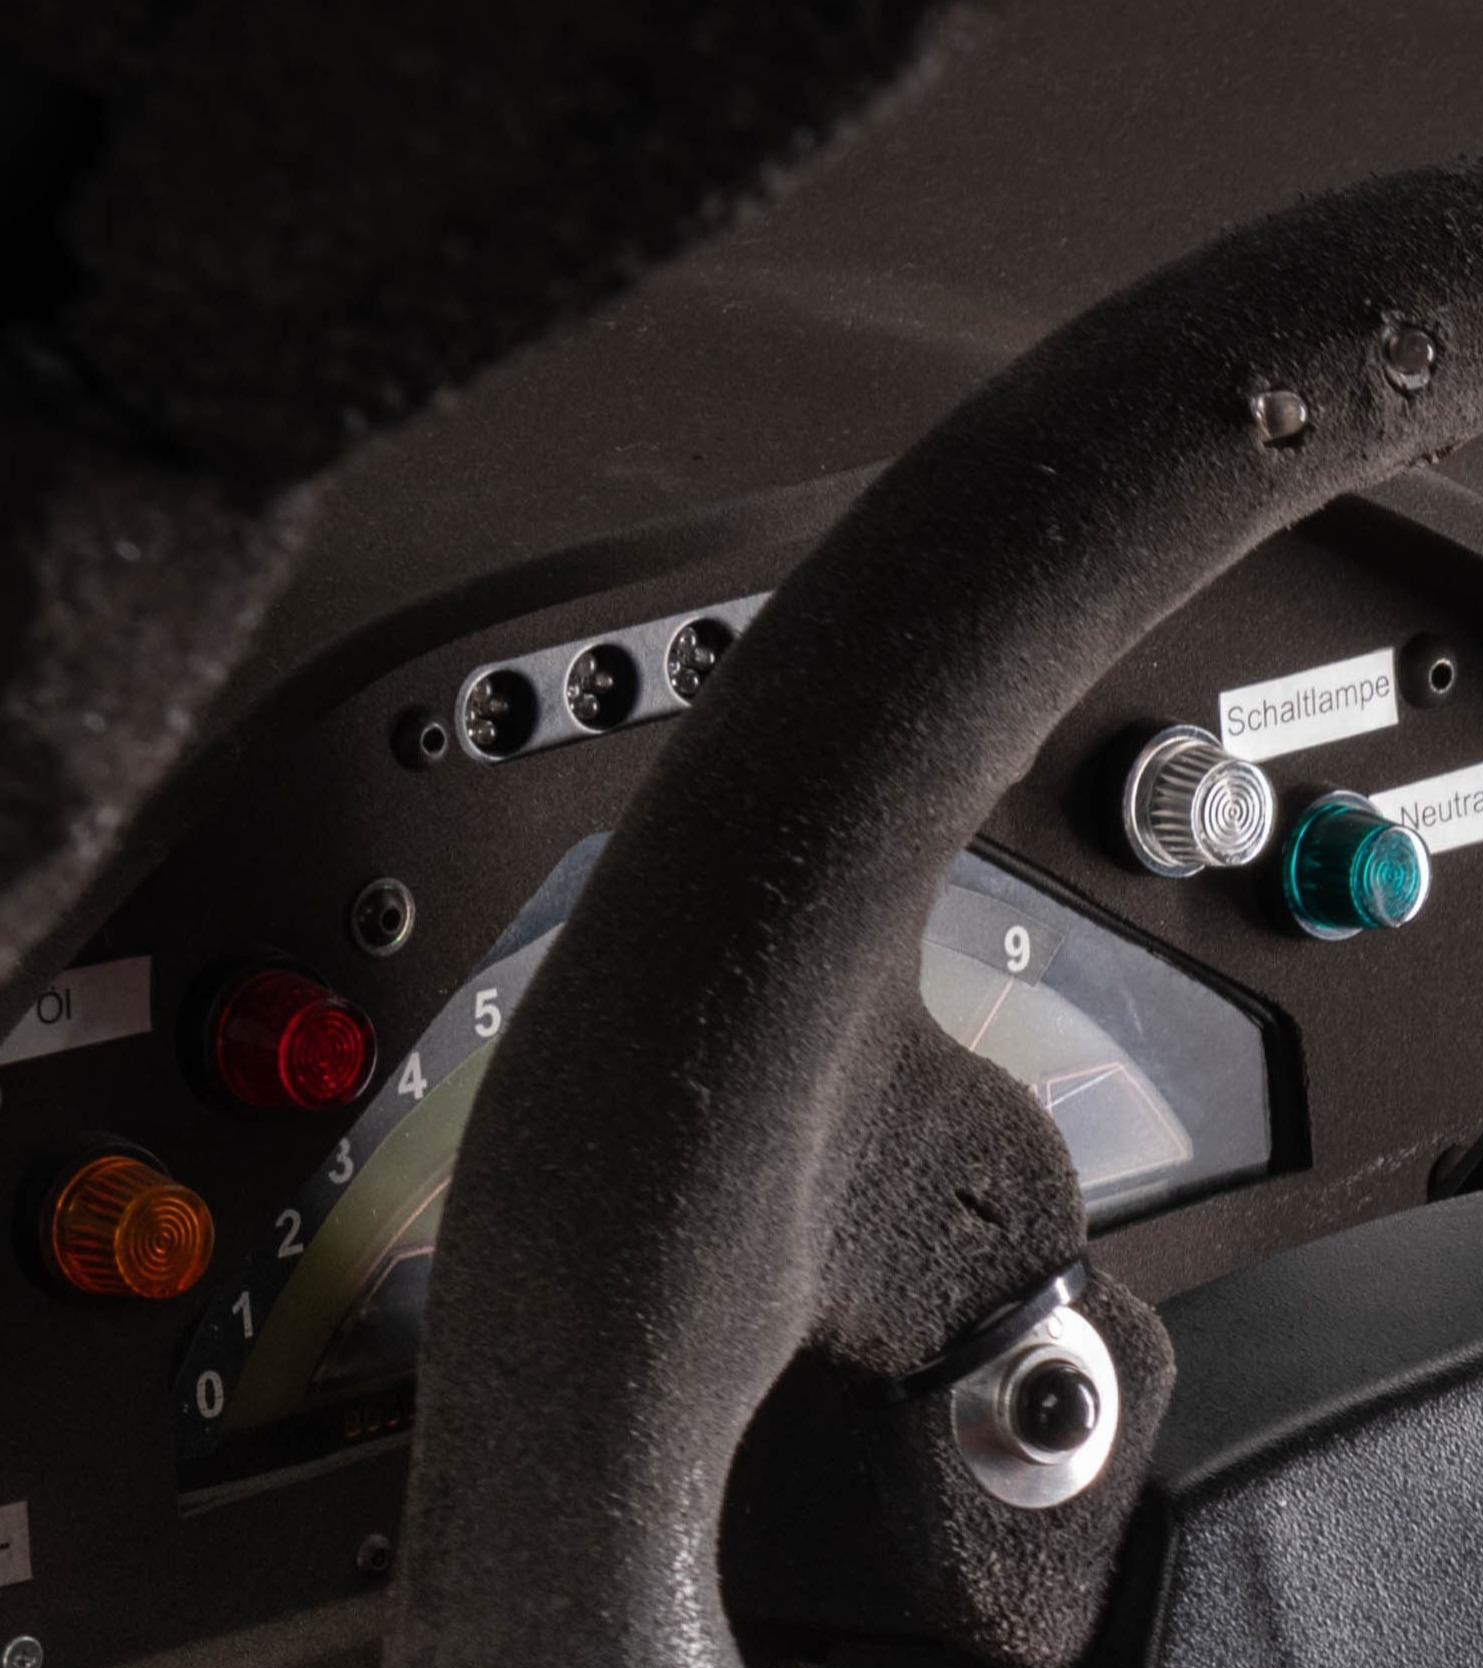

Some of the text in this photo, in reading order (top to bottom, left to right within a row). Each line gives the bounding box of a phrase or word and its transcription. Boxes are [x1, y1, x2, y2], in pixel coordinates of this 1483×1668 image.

[1226, 667, 1392, 737] Schaltlampe
[1003, 924, 1032, 974] 9
[472, 988, 503, 1039] 5
[397, 1051, 428, 1101] 4
[326, 1136, 356, 1184] 3
[274, 1209, 305, 1259] 2
[231, 1289, 257, 1339] 1
[195, 1370, 225, 1420] 0
